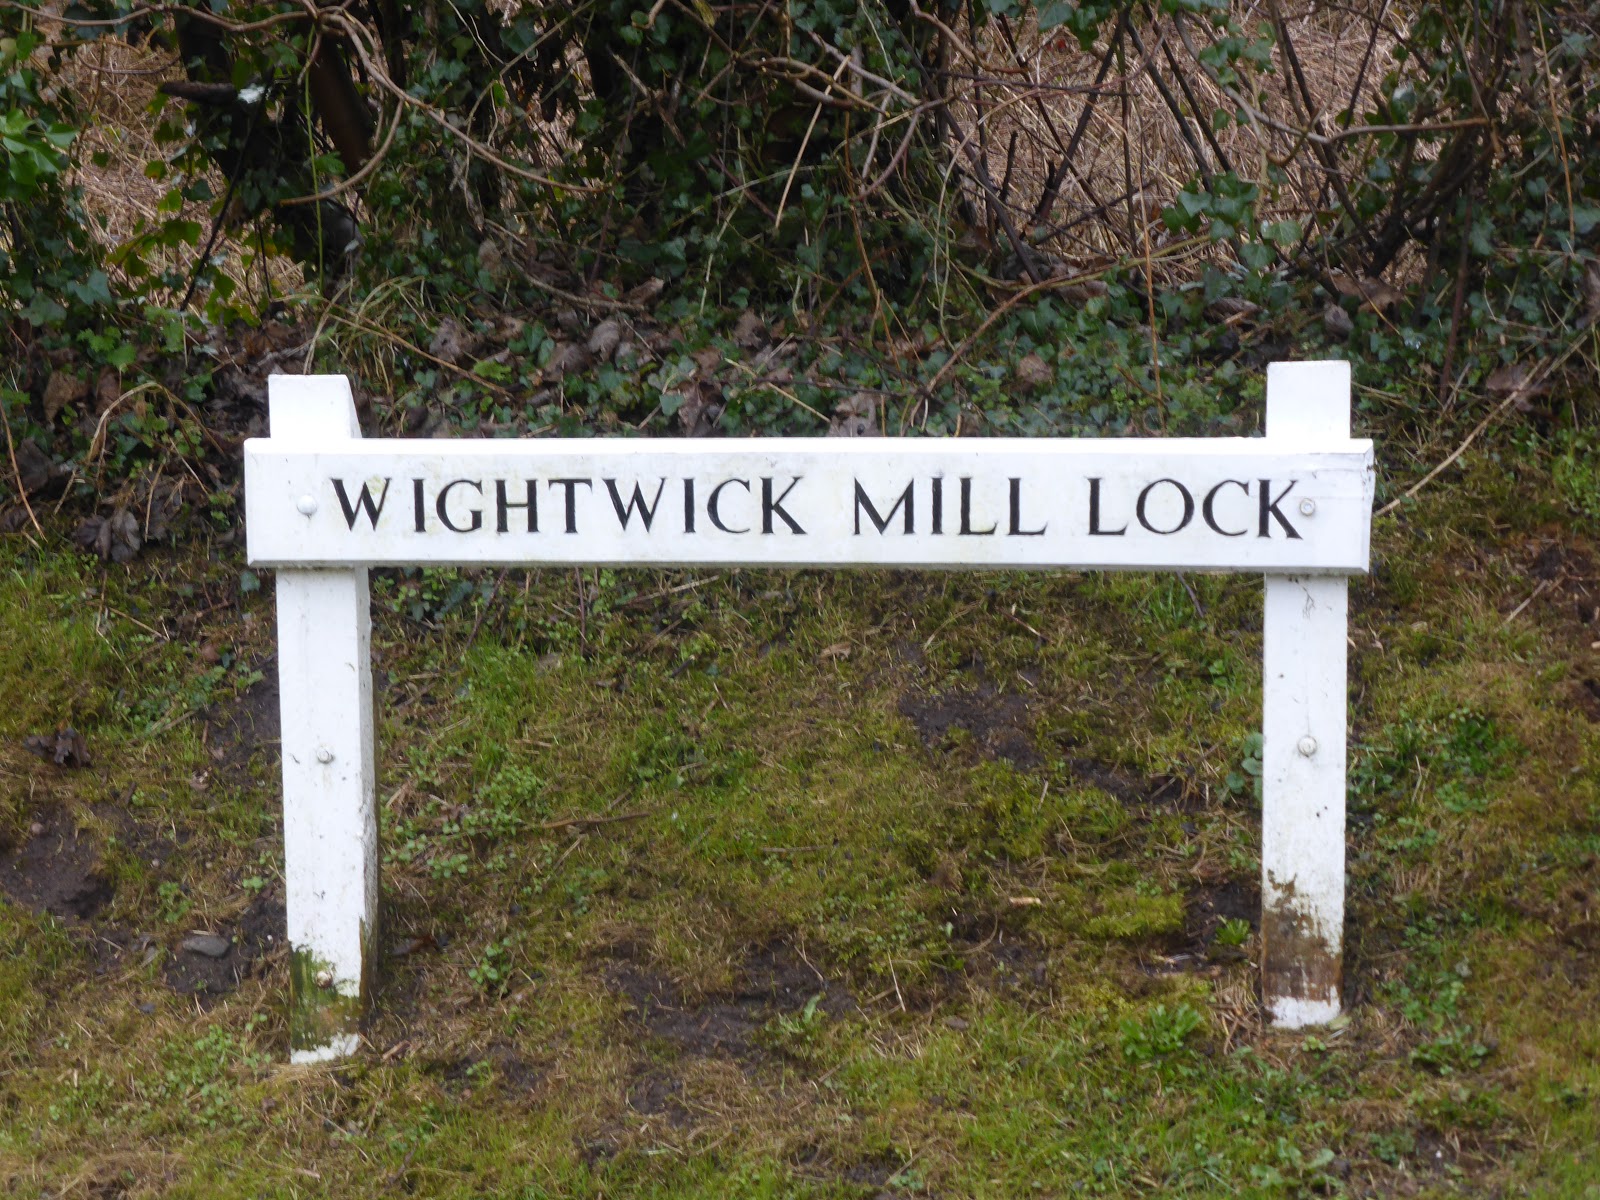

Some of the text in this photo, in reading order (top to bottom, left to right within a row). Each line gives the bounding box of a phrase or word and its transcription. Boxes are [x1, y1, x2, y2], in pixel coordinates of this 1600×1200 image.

[330, 476, 1303, 539] WIGHTWICK MILL LOCK
